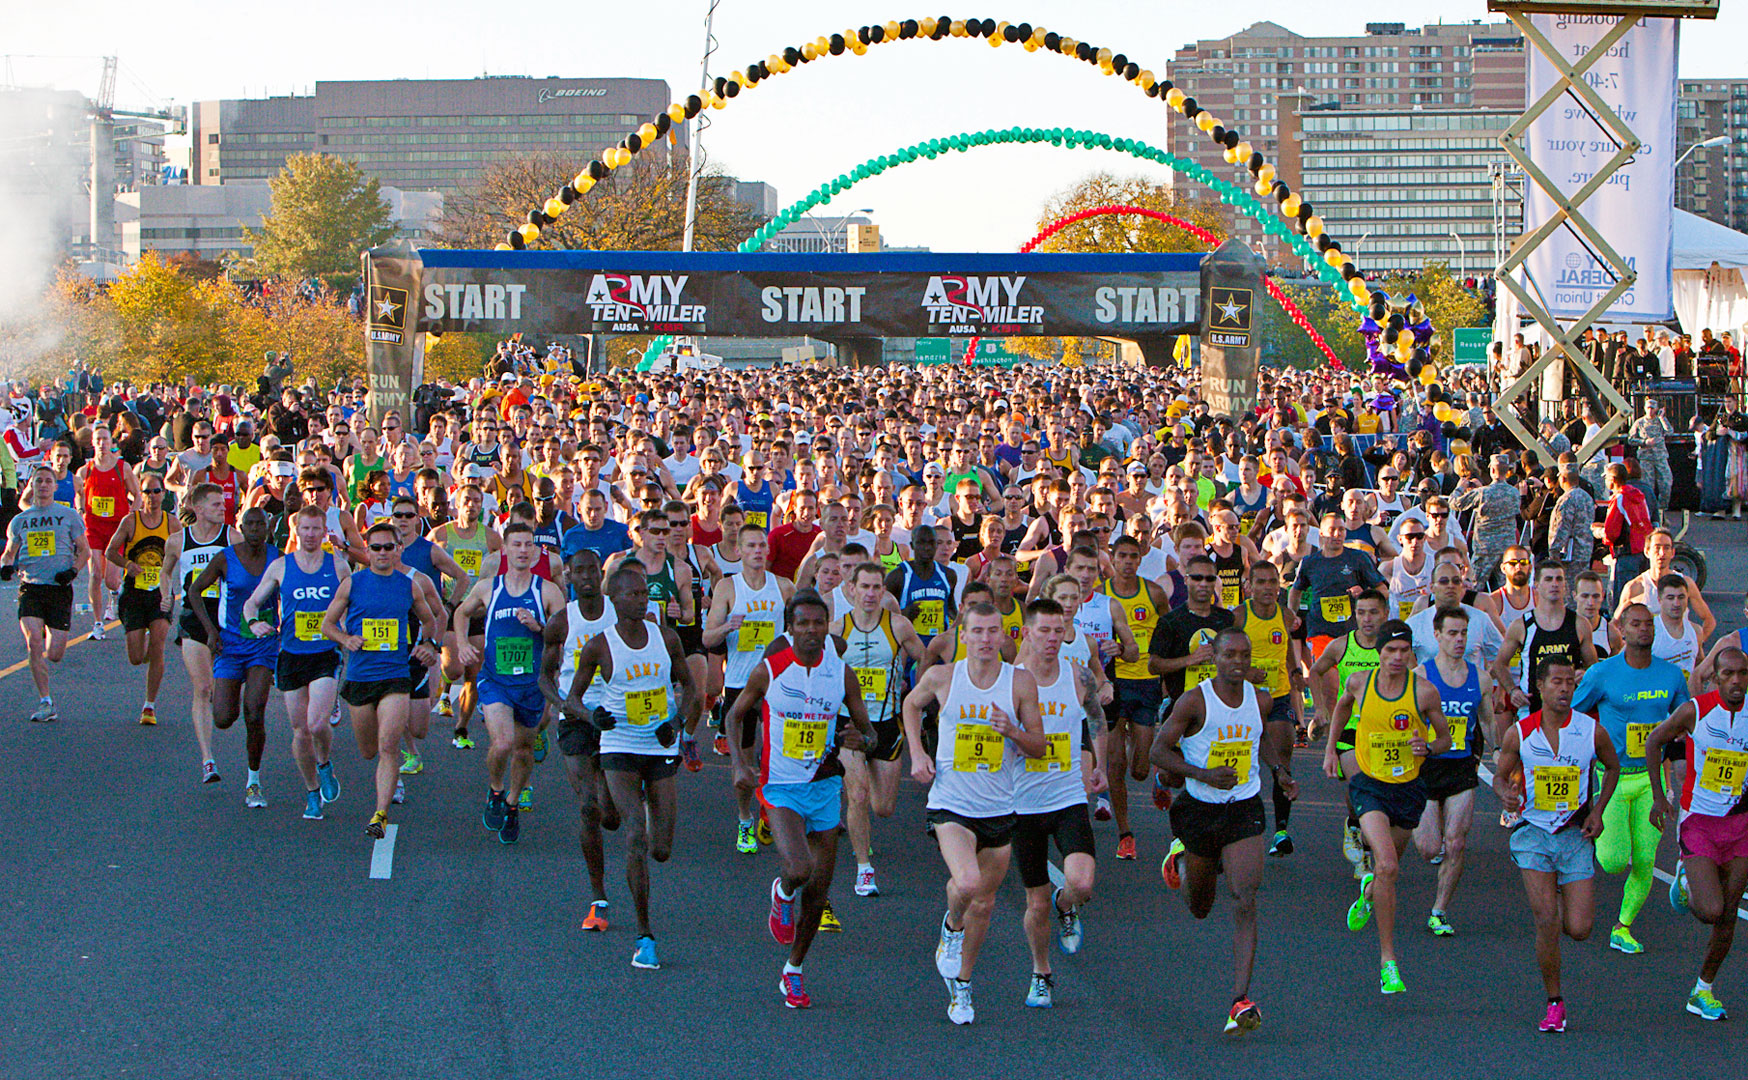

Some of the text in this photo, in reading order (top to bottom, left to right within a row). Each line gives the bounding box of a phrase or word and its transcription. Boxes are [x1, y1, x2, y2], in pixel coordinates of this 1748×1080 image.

[585, 274, 689, 306] ARMY
[921, 276, 1026, 307] ARMY
[424, 283, 527, 320] START
[761, 286, 866, 323] START
[1095, 287, 1200, 323] START
[590, 304, 707, 322] TEN-MILER
[926, 306, 1045, 323] TEN-MILER
[612, 323, 640, 332] AUSA
[653, 323, 684, 332] KBR
[949, 325, 976, 334] AUSA
[991, 325, 1021, 333] KBR
[369, 374, 400, 388] RUN
[1210, 376, 1246, 394] RUN
[373, 391, 407, 406] RMY
[1206, 394, 1252, 411] ARMY
[22, 516, 65, 530] ARMY
[34, 538, 49, 547] 229
[461, 556, 476, 566] 265
[143, 573, 157, 582] 159
[293, 586, 331, 600] GRC
[746, 600, 776, 613] ARMY
[1328, 603, 1344, 612] 299
[494, 607, 511, 620] FORT
[921, 613, 938, 624] 247
[307, 619, 319, 629] 62
[372, 627, 389, 638] 151
[754, 628, 759, 639] 7
[1538, 644, 1570, 654] ARMY
[502, 651, 527, 662] 1707
[625, 662, 661, 680] ARMY
[860, 676, 873, 687] 34
[1637, 690, 1668, 701] RUN
[644, 698, 652, 710] 5
[1441, 701, 1473, 714] GRC
[799, 731, 814, 744] 18
[974, 734, 1003, 743] TEN-MILER
[1218, 724, 1252, 741] ARMY
[975, 742, 983, 756] 9
[1211, 749, 1250, 758] ARMY TEN-MILER
[1384, 749, 1400, 761] 33
[1224, 758, 1238, 770] 12
[1707, 756, 1747, 768] ARMY TEN-MILER
[1718, 766, 1733, 780] 16
[1546, 782, 1569, 796] 128
